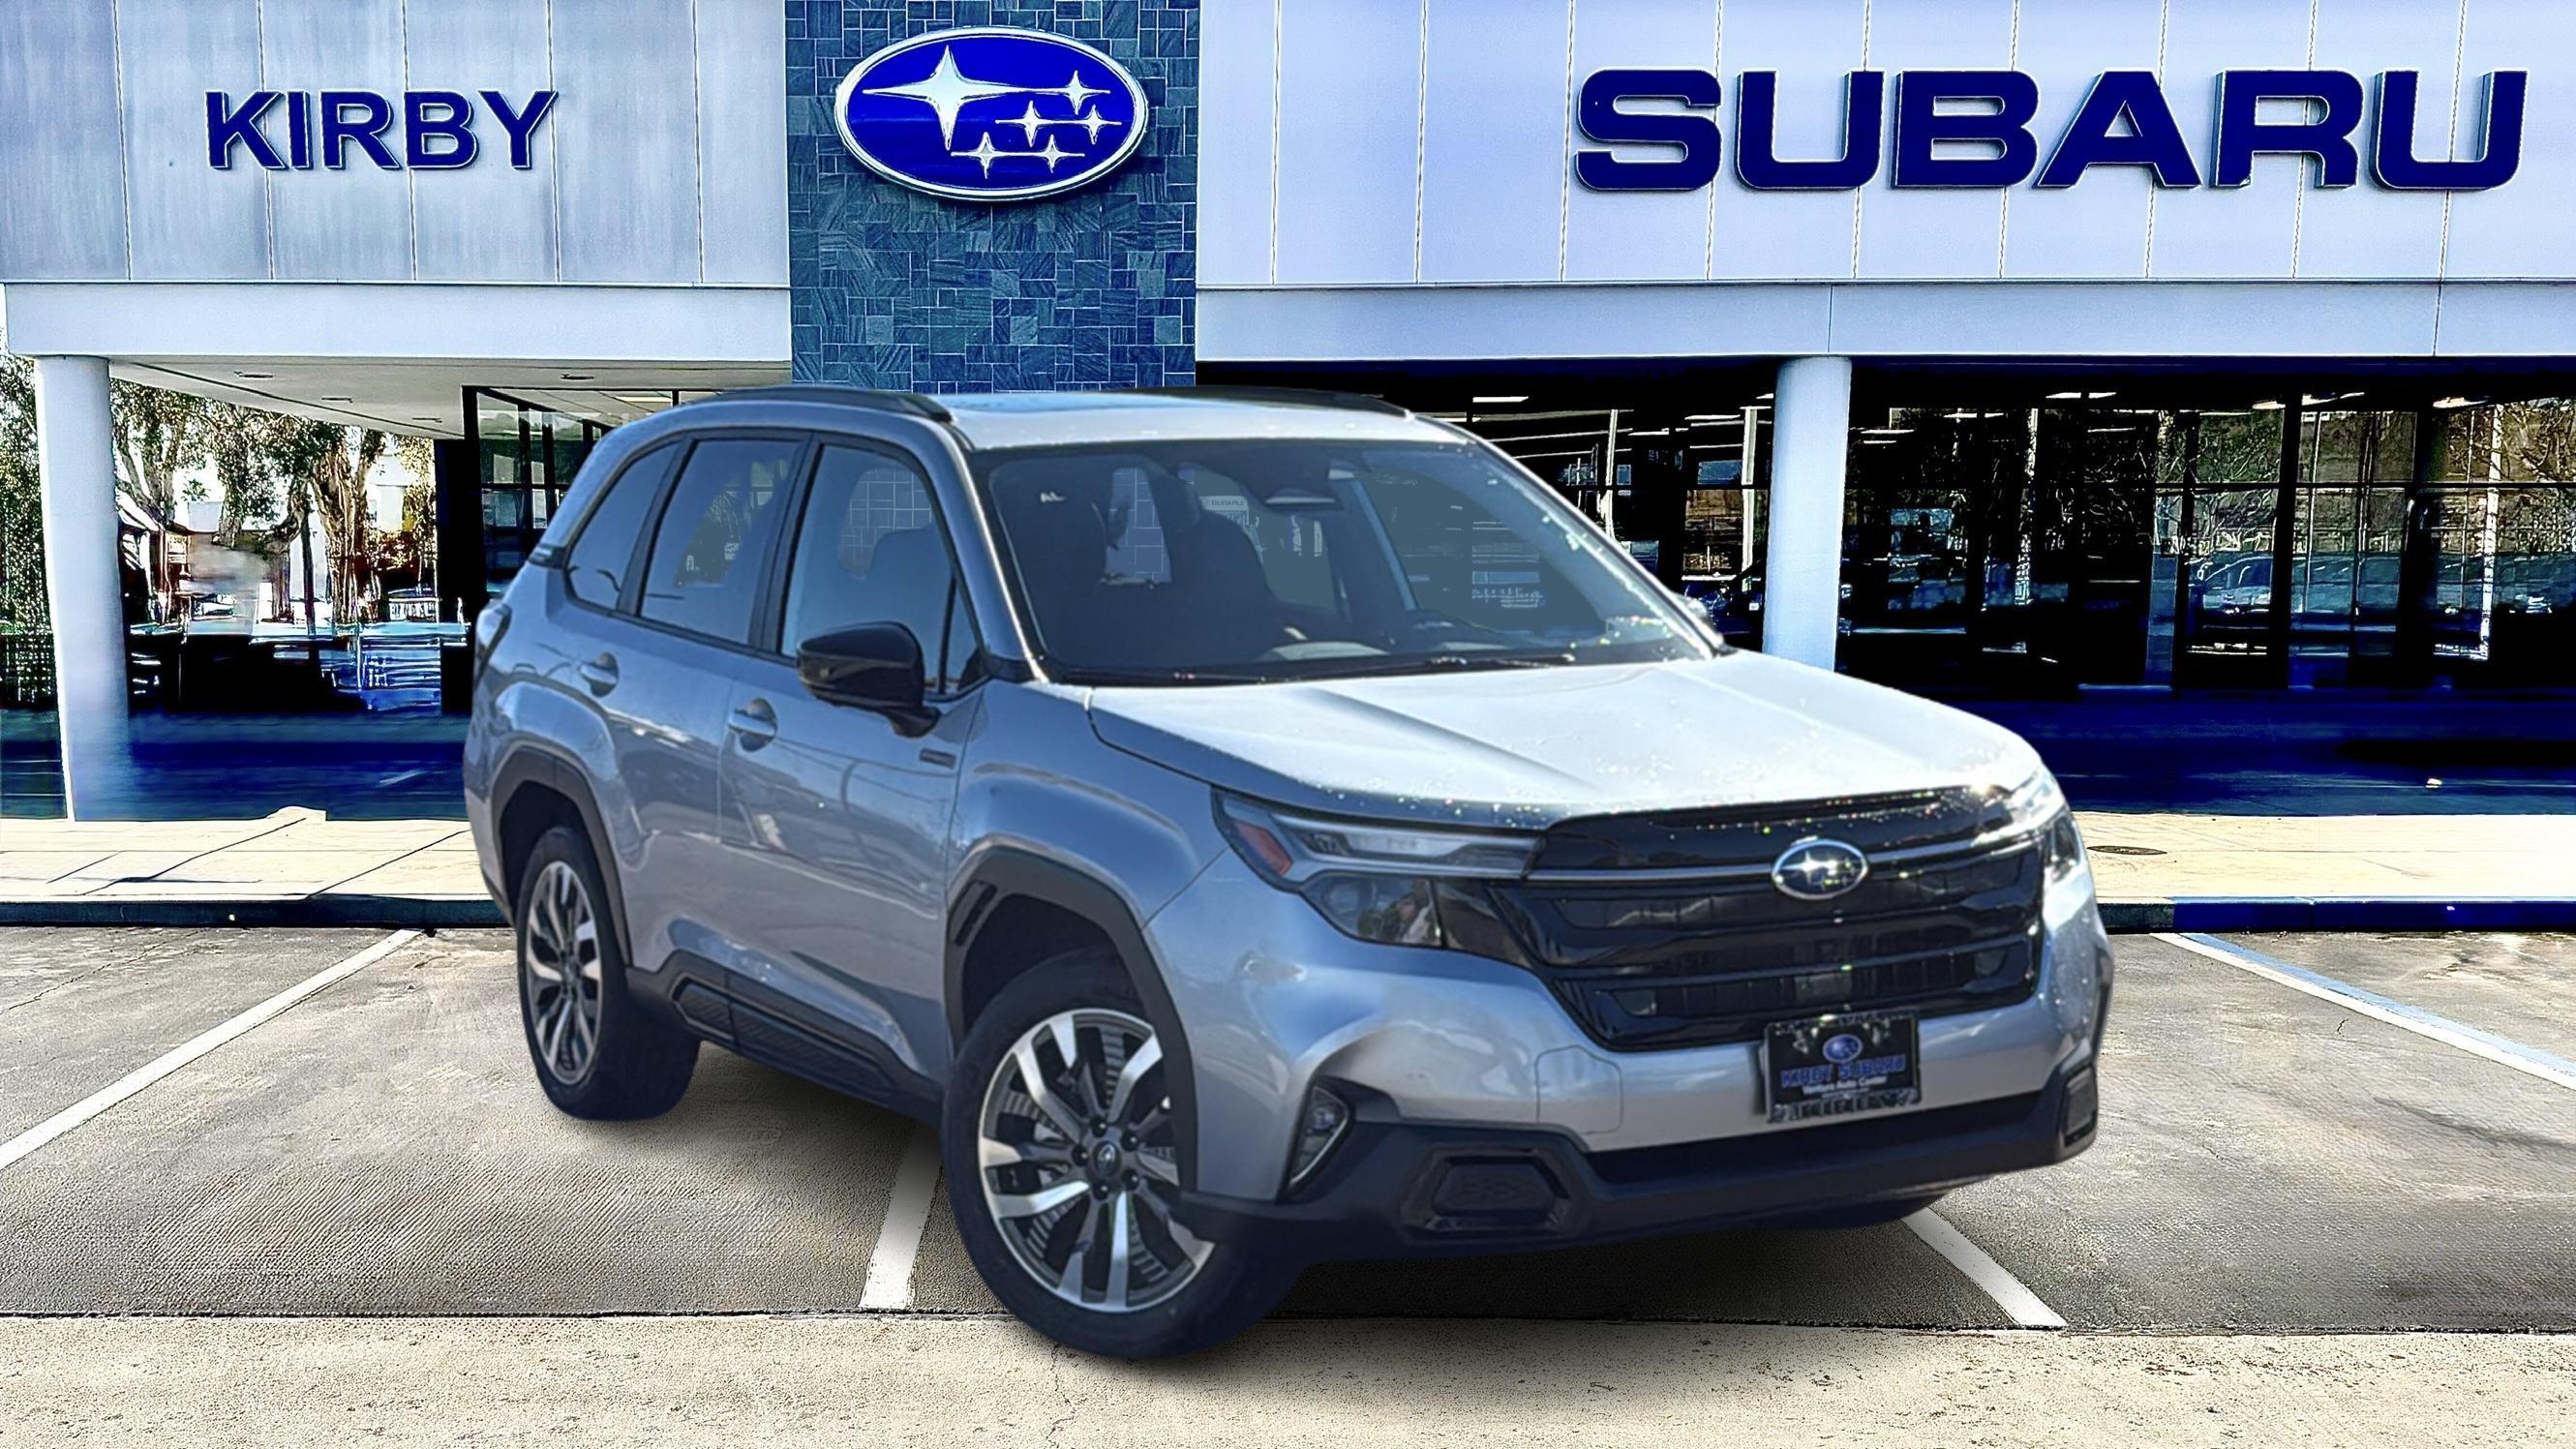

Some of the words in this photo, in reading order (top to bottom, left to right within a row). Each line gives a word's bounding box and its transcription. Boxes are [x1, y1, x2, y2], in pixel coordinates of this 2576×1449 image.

[204, 89, 559, 169] KIRBY
[1575, 69, 2526, 192] SUBARU
[1782, 1065, 1833, 1088] KIRBY
